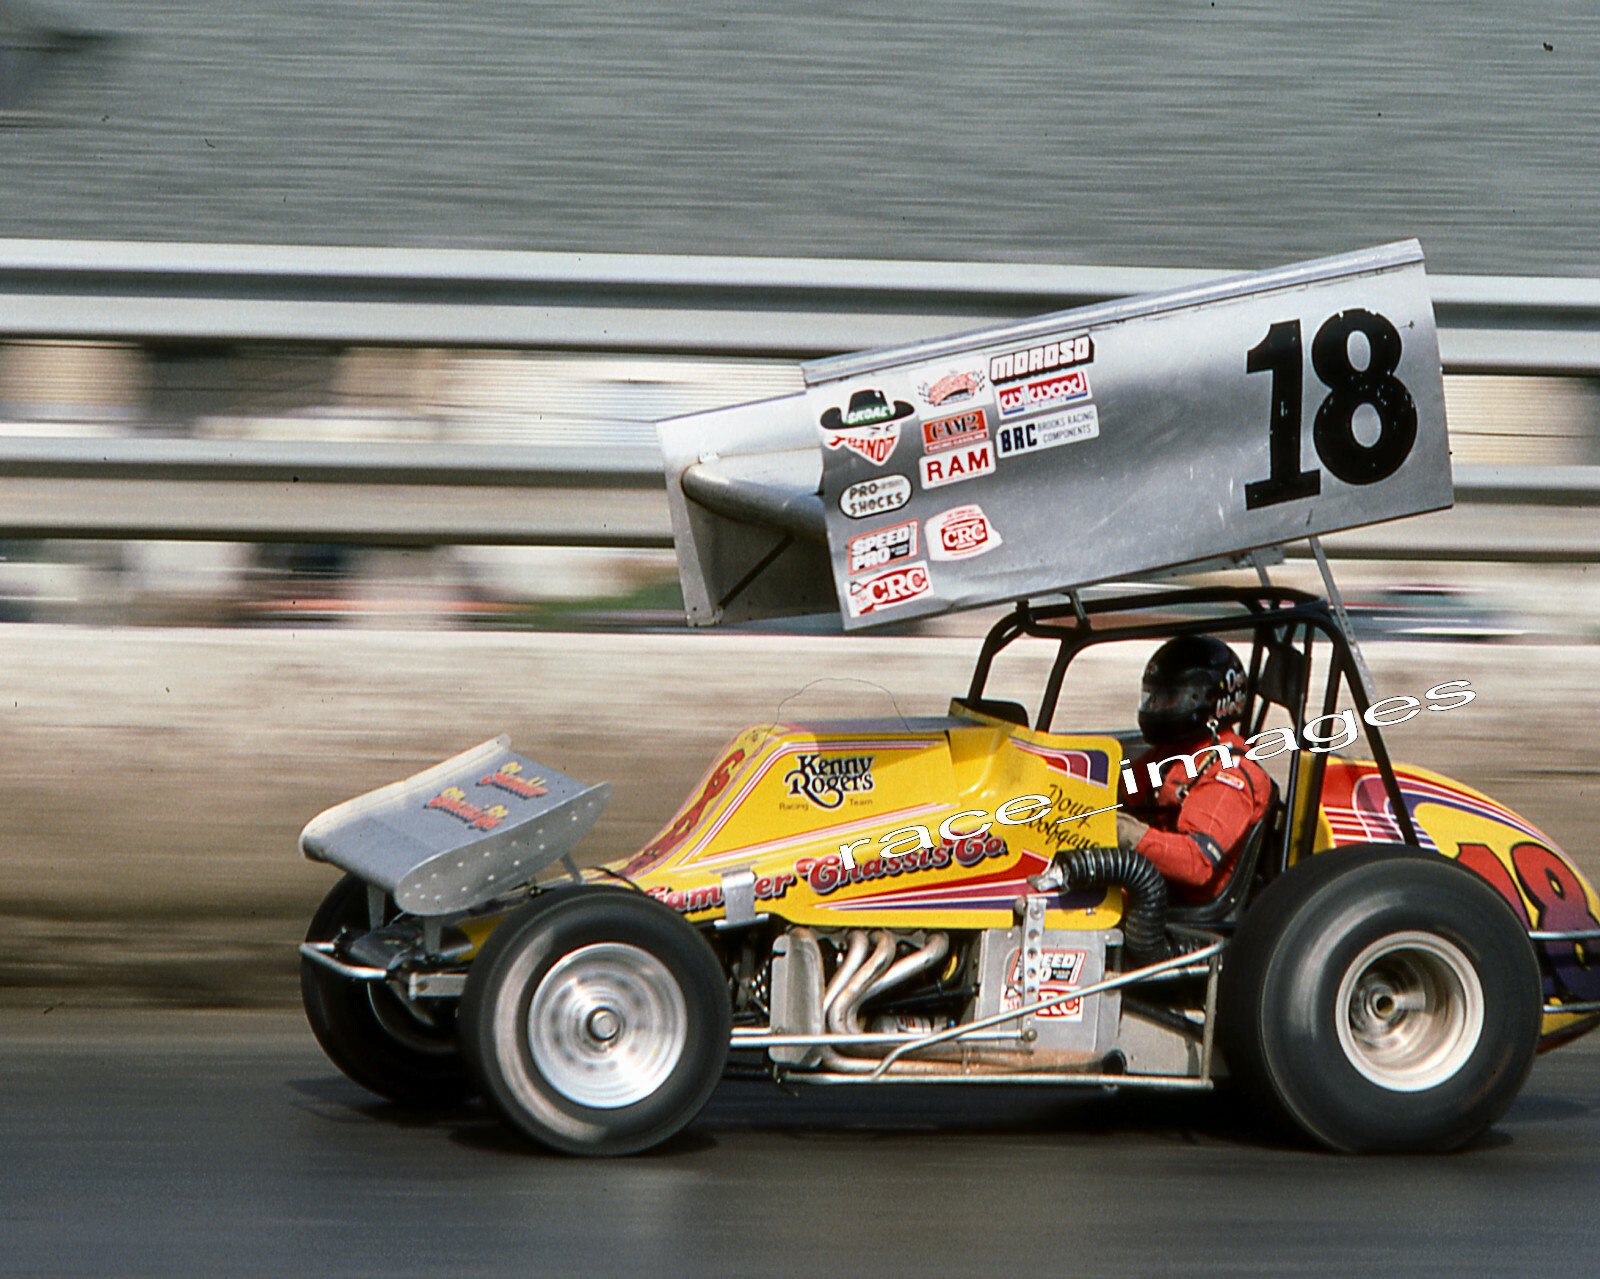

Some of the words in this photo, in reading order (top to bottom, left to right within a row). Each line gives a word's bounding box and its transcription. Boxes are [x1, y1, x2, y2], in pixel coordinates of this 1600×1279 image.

[989, 335, 1092, 383] MOROSO
[1244, 308, 1418, 511] 18
[931, 414, 977, 440] CAM2
[1000, 423, 1038, 453] BRC
[926, 447, 989, 482] RAM
[850, 492, 903, 515] SHOCKS
[851, 526, 910, 555] SPEED
[943, 523, 986, 548] CRC
[851, 547, 890, 571] PRO
[868, 569, 928, 603] CRC
[796, 753, 875, 781] Kenny
[785, 769, 874, 809] Rogers
[779, 802, 809, 811] Racing
[849, 798, 873, 807] Team
